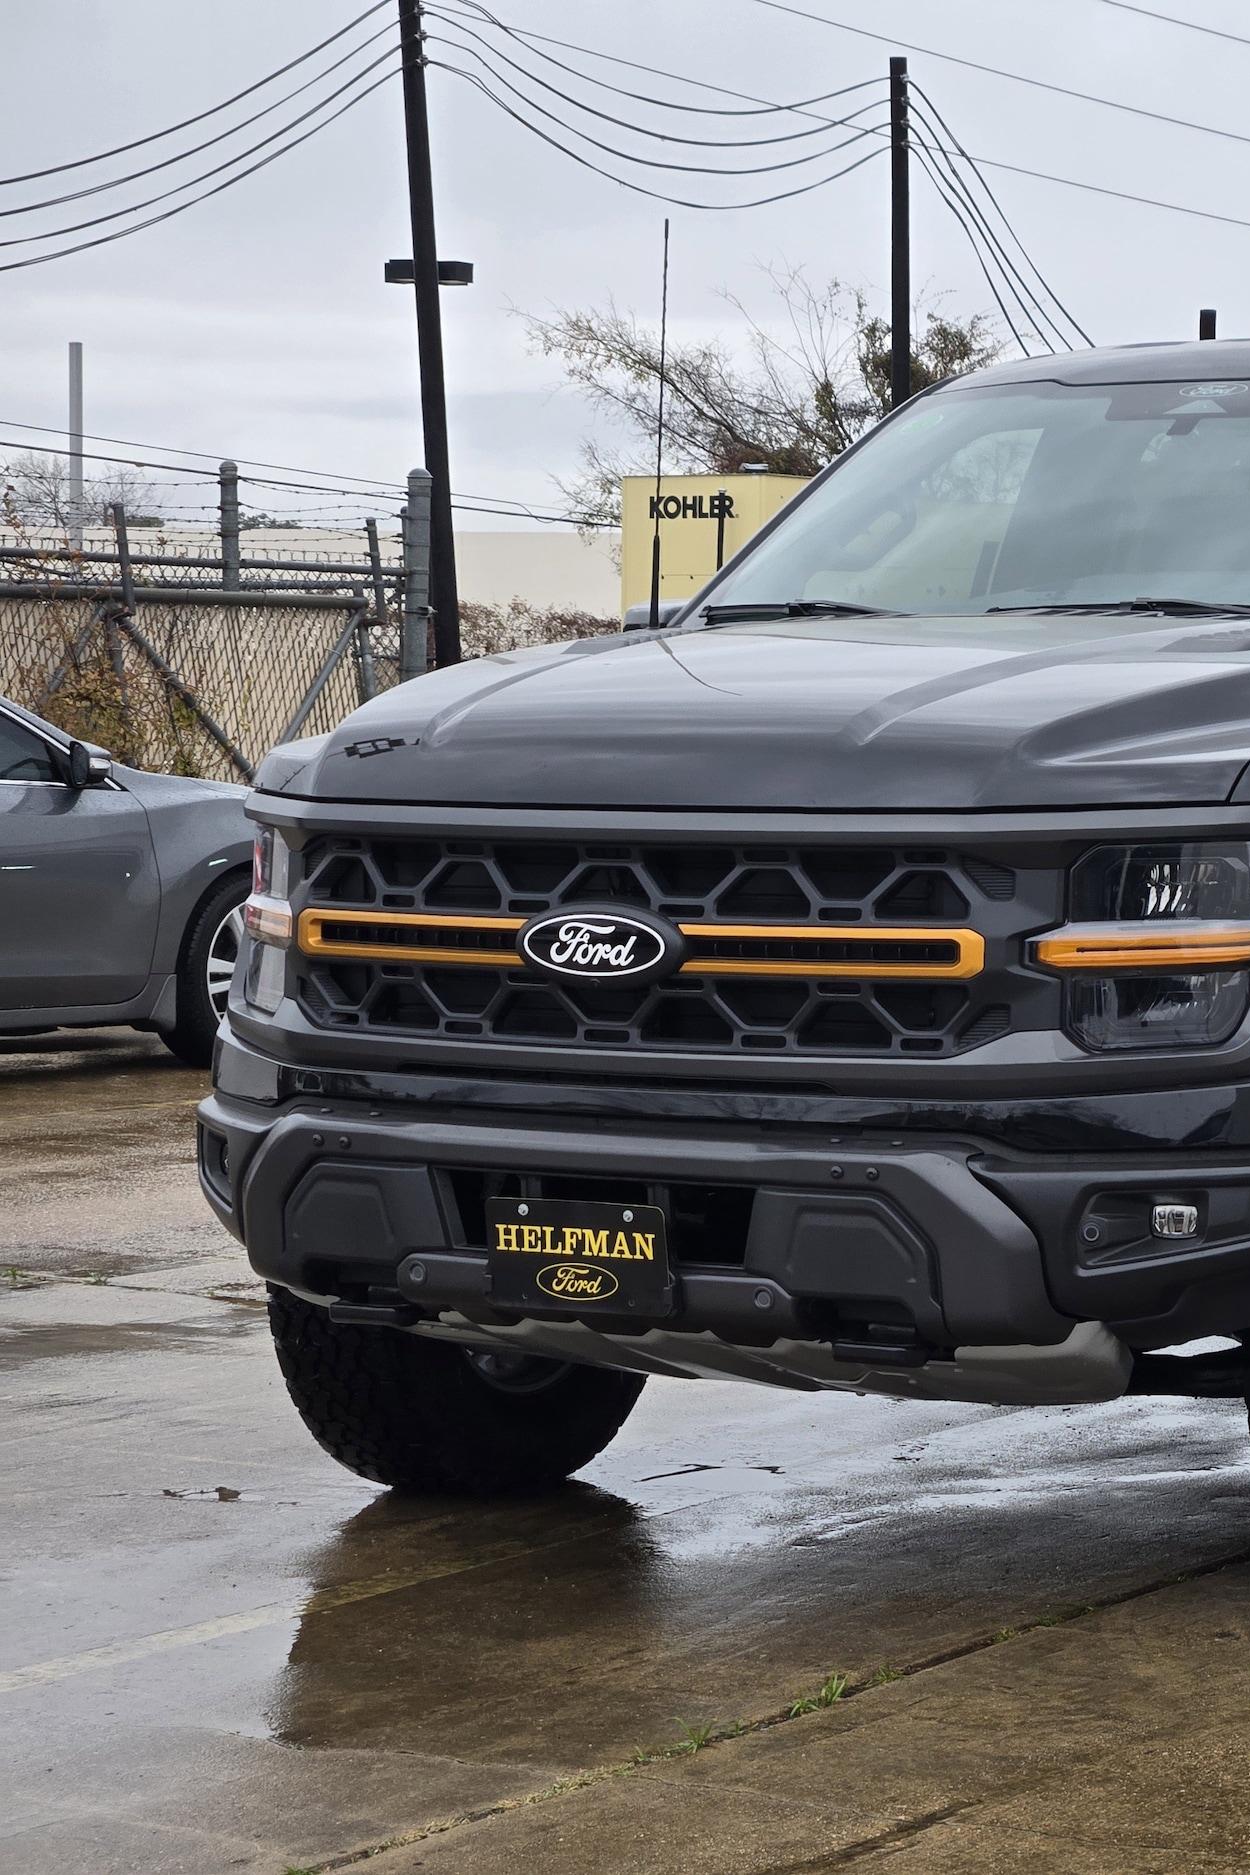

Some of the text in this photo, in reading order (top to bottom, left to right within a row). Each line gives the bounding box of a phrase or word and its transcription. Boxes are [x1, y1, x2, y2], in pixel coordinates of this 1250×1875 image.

[649, 495, 735, 519] KOHLER
[550, 921, 637, 966] Ford
[495, 1224, 655, 1260] HELFMAN
[552, 1266, 603, 1294] Ford
